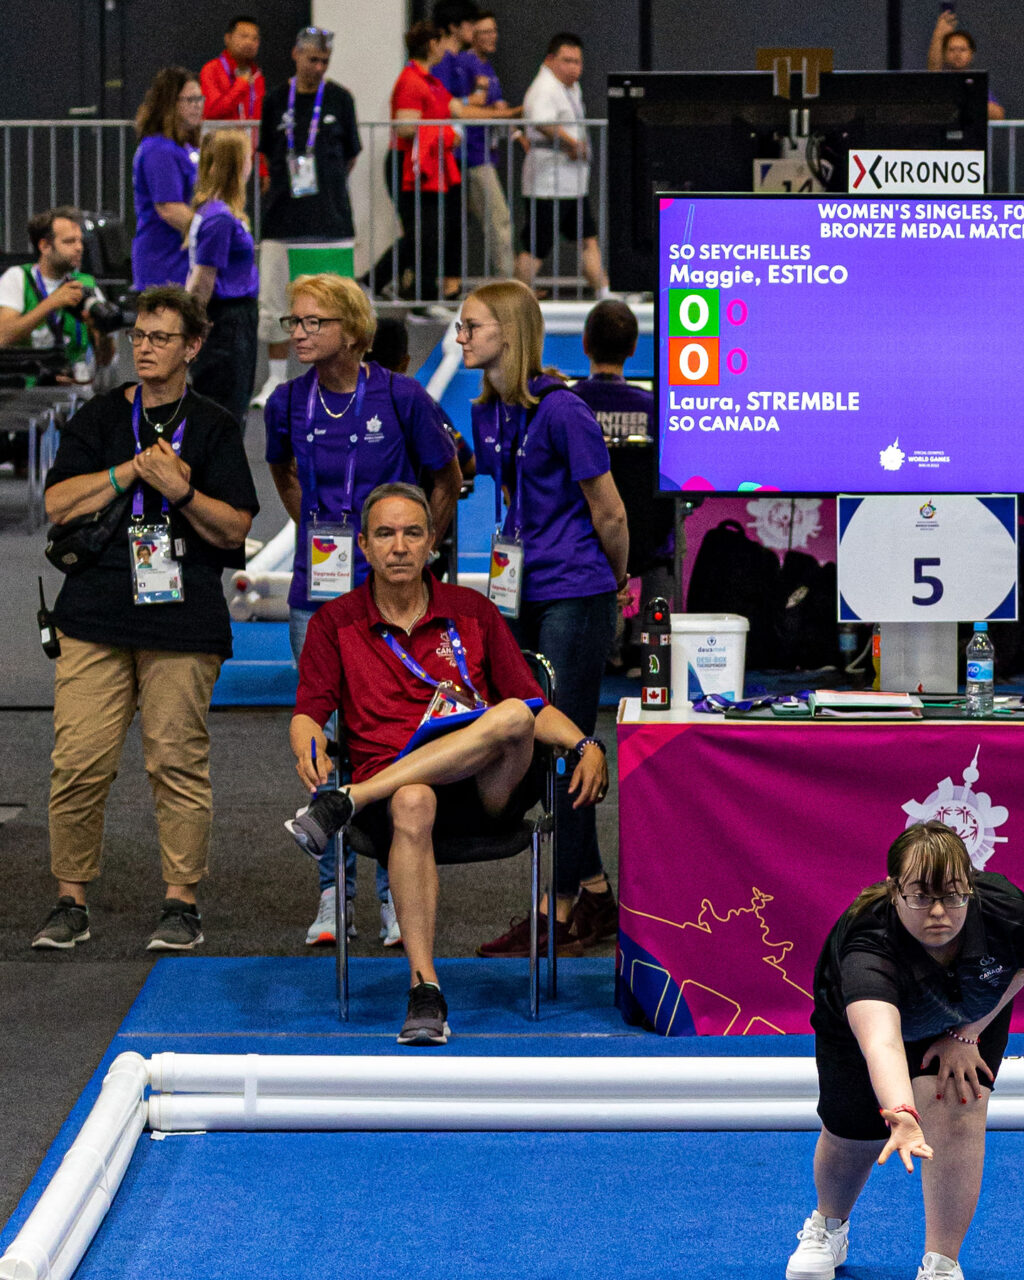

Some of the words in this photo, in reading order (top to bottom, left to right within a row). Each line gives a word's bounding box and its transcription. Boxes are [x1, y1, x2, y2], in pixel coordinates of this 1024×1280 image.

[818, 203, 911, 219] WOMEN'S
[915, 204, 998, 221] SINGLES,
[820, 223, 896, 238] BRONZE
[901, 223, 965, 239] MEDAL
[669, 244, 695, 260] SO
[699, 244, 811, 260] SEYCHELLES
[669, 264, 761, 288] Maggie,
[768, 265, 848, 284] ESTICO
[679, 294, 709, 331] 0
[726, 298, 748, 326] 0
[679, 344, 709, 381] 0
[726, 348, 748, 376] 0
[669, 391, 741, 413] Laura,
[746, 392, 860, 411] STREMBLE
[668, 416, 695, 431] SO
[698, 416, 780, 431] CANADA
[912, 557, 944, 606] 5
